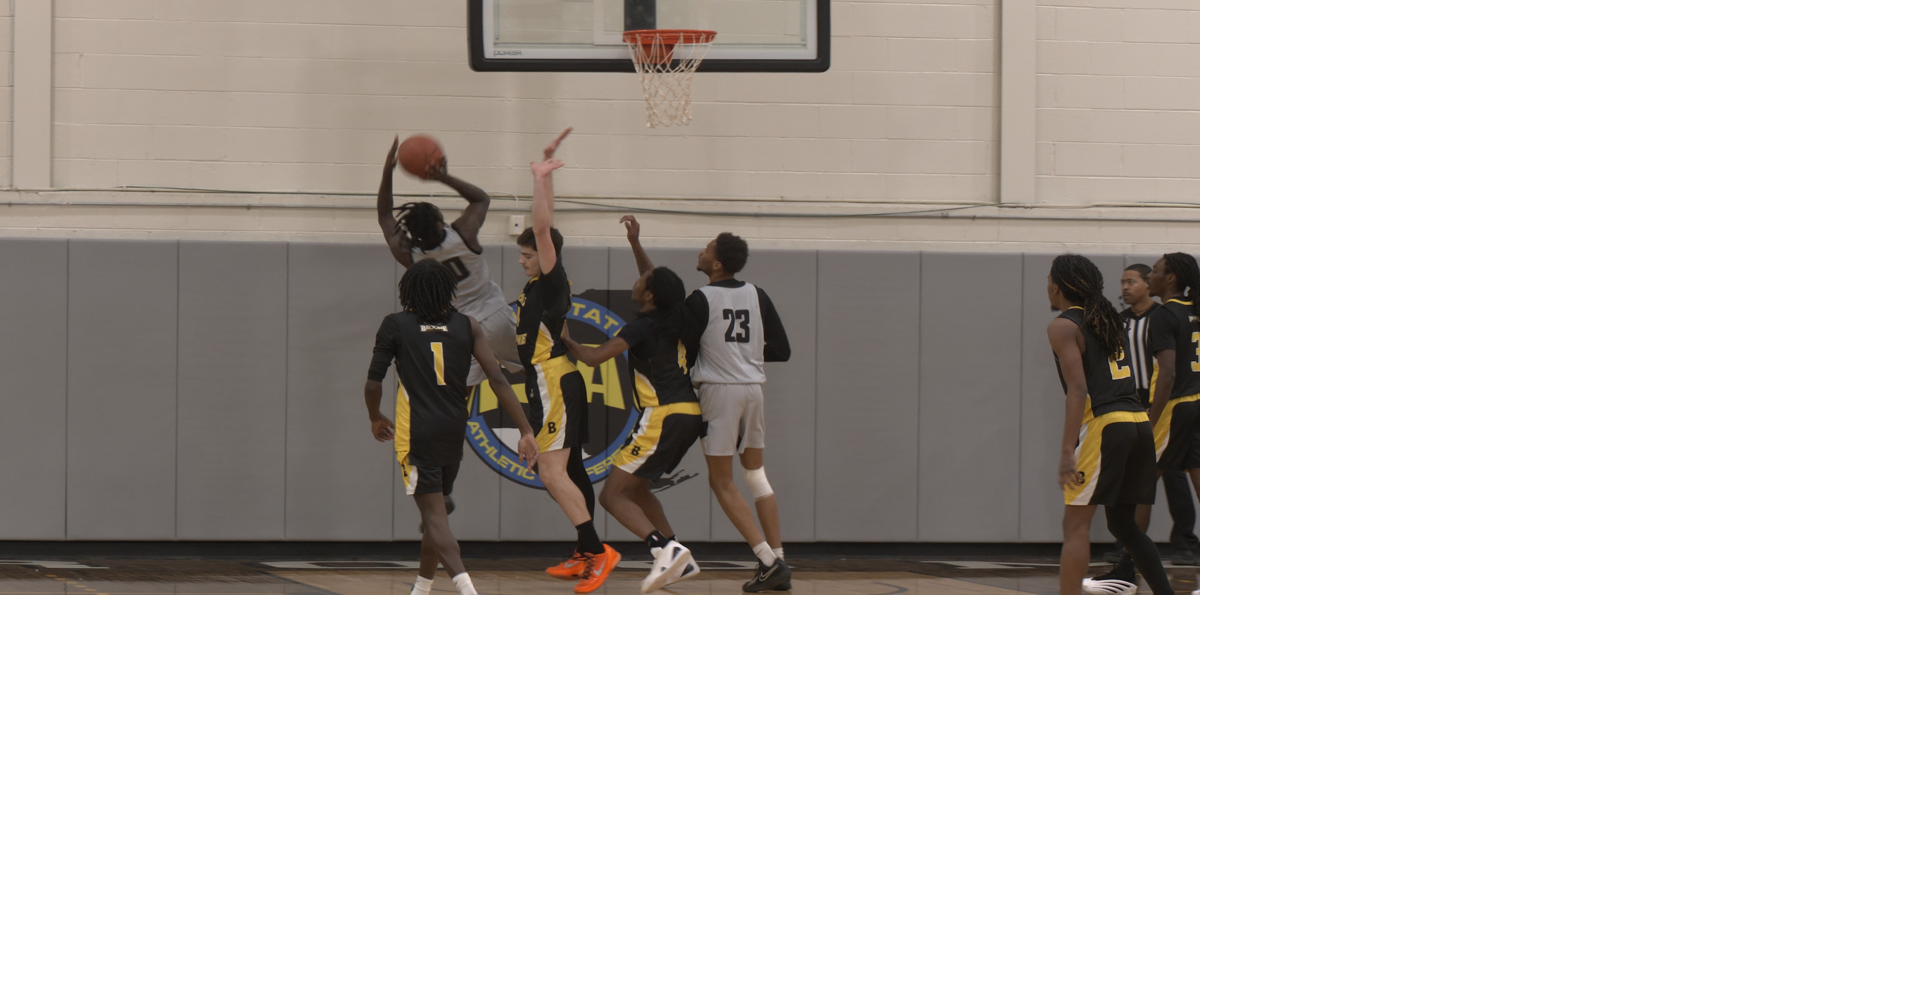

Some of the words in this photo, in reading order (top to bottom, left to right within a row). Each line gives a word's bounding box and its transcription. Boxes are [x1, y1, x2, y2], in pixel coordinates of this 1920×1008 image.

[722, 308, 750, 343] 23
[430, 342, 447, 386] 1
[1108, 338, 1131, 380] 2
[547, 421, 557, 434] B
[467, 420, 536, 480] ATHLETIC
[630, 445, 641, 456] B
